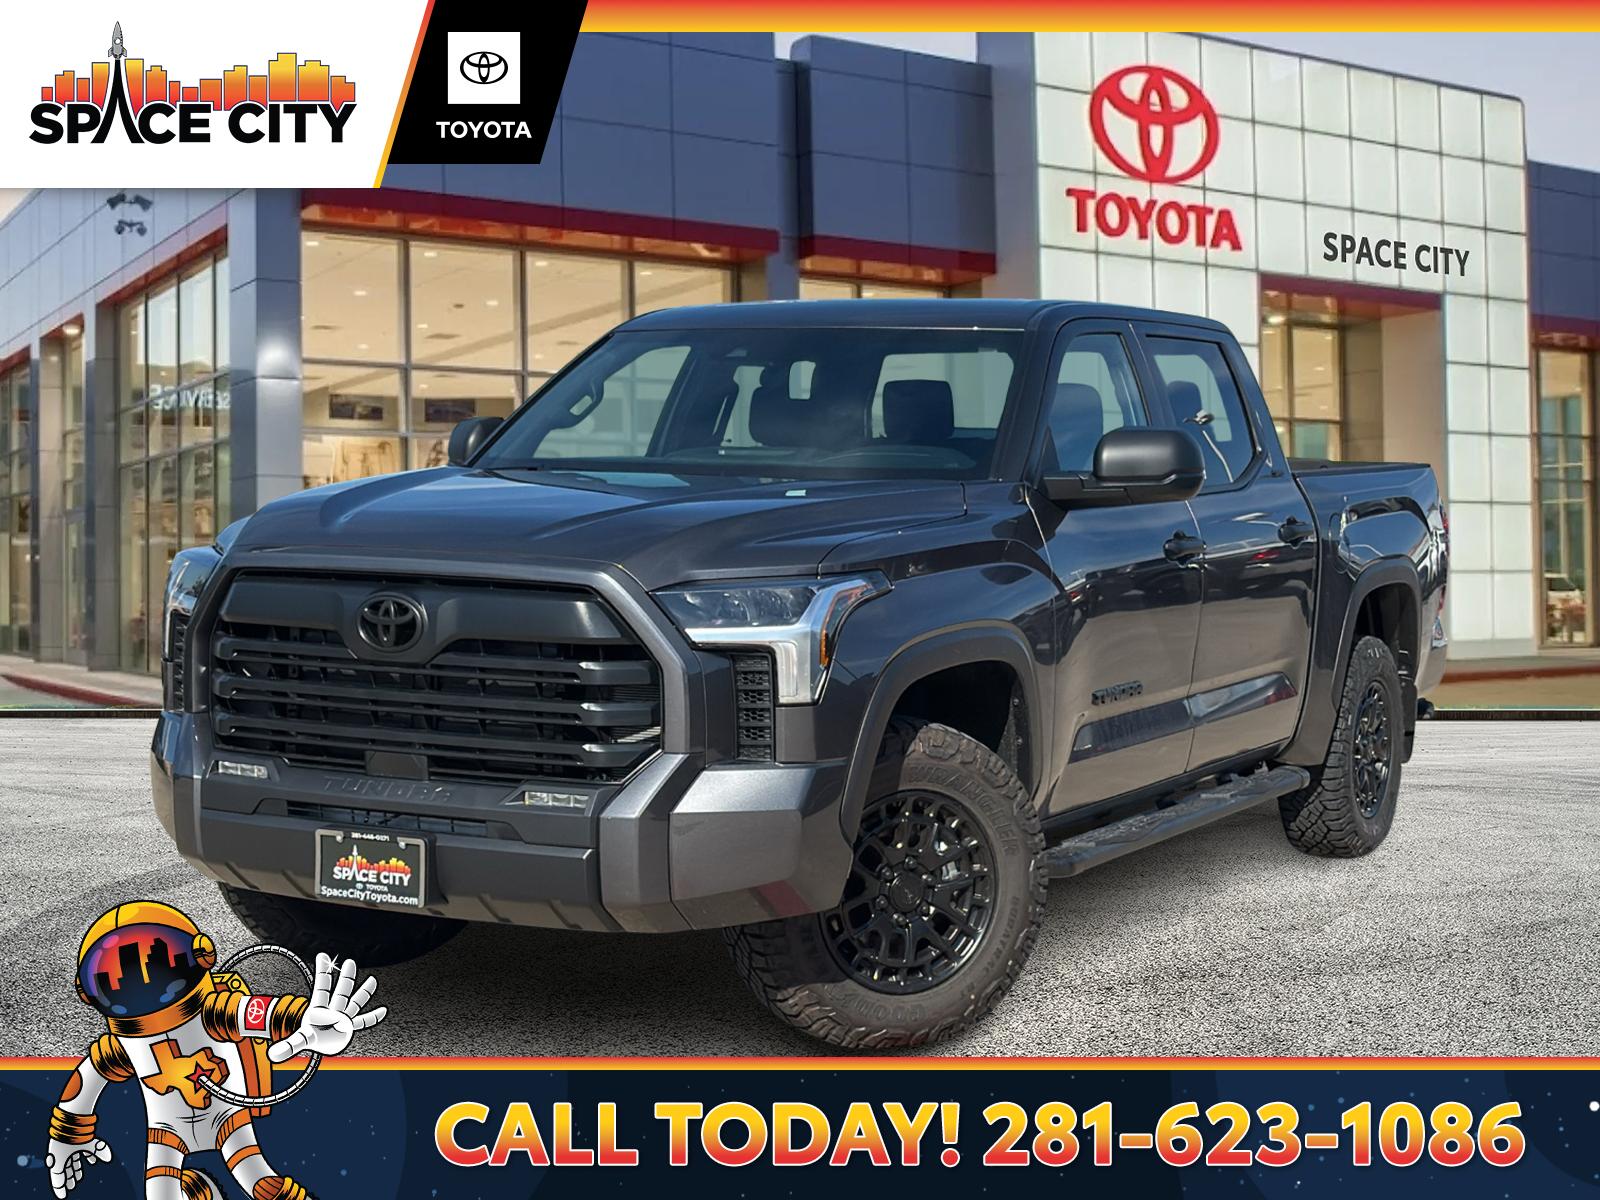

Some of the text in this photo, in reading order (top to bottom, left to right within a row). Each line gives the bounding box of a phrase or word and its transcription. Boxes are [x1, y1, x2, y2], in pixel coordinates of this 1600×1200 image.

[1066, 187, 1243, 251] TOYOTA
[1323, 231, 1470, 277] SPACE CITY
[908, 764, 1019, 858] WRANGLER
[332, 864, 412, 887] SPACE CITY
[365, 883, 389, 893] TOYOTA
[320, 885, 419, 905] SpaceCityToyota.com
